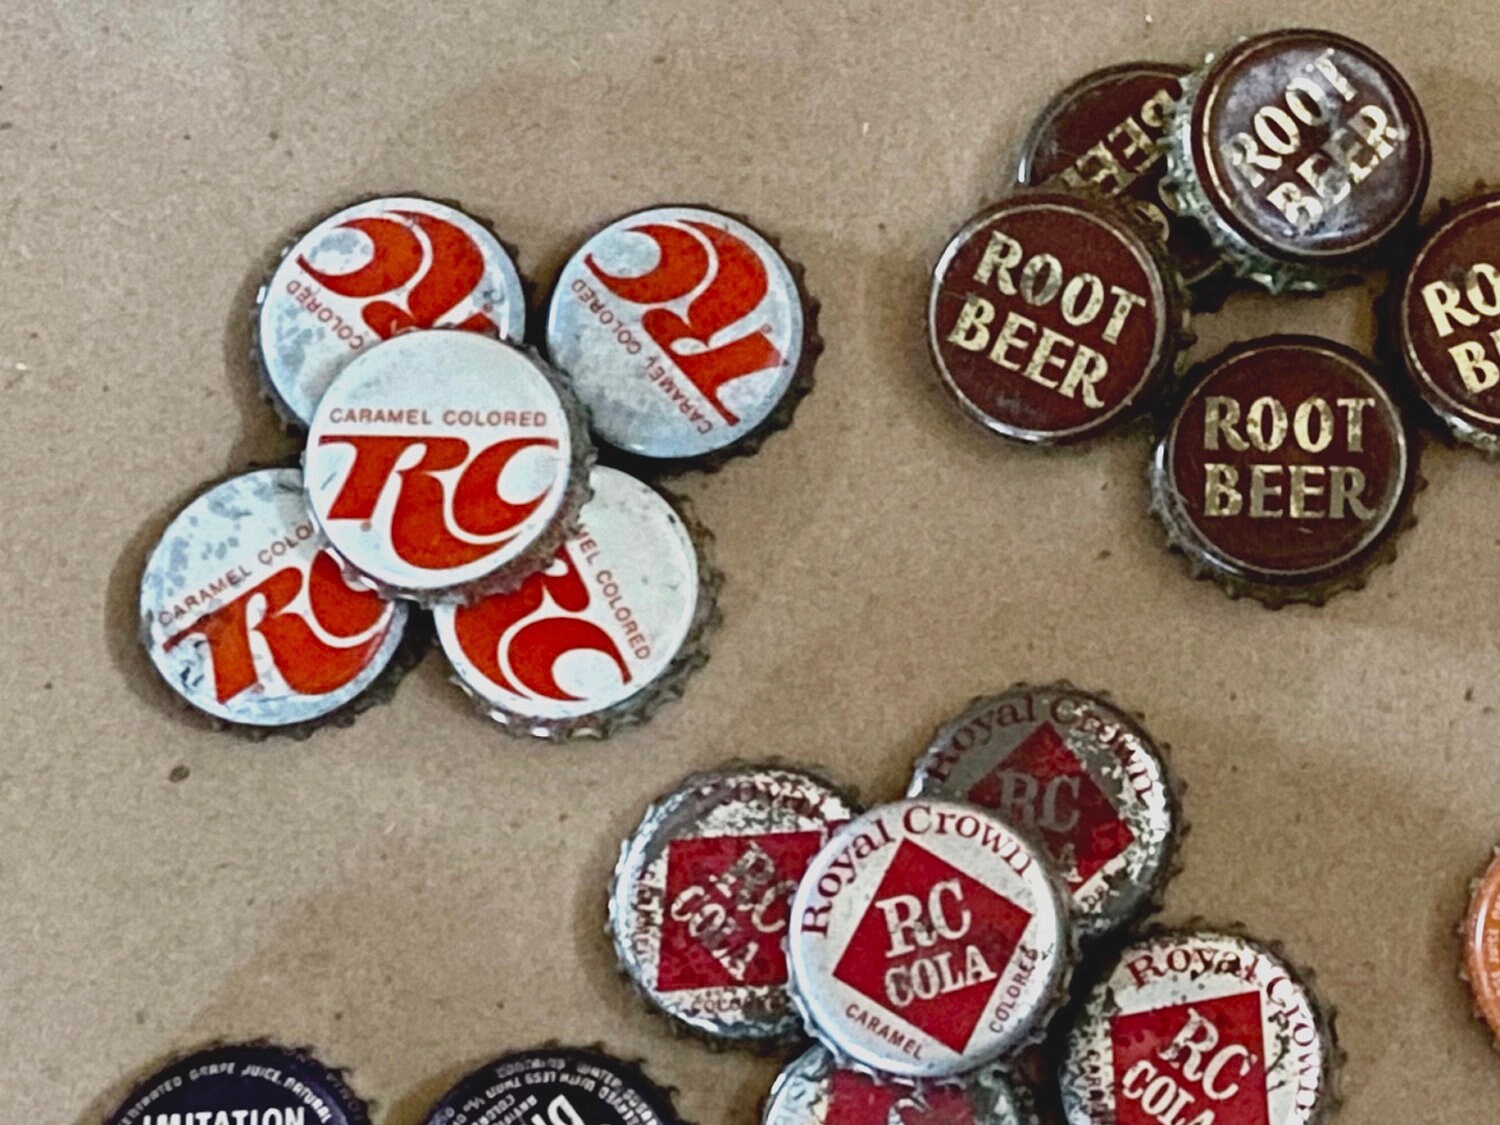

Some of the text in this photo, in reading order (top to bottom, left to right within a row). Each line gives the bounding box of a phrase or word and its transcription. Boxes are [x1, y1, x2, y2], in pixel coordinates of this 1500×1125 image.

[1061, 89, 1175, 196] BEE
[1222, 49, 1358, 188] ROOT
[1267, 105, 1409, 232] BEER
[584, 219, 789, 426] RC
[972, 230, 1147, 347] ROOT
[570, 277, 713, 435] CARAMEL COLORED
[947, 297, 1110, 410] BEER
[329, 407, 548, 428] CARAMEL COLORED
[1204, 396, 1375, 453] ROOT
[318, 435, 559, 570] RC
[1203, 463, 1377, 520] BEER
[159, 565, 253, 627] CARAMEL
[162, 548, 394, 706] RC
[596, 567, 651, 662] COLORED
[926, 693, 1036, 784] Royal
[1000, 767, 1082, 833] RC
[801, 818, 896, 938] Royal
[903, 805, 1035, 877] Crown
[875, 878, 972, 959] RC
[884, 944, 998, 1009] COLA
[988, 943, 1040, 1034] COLORED
[1126, 948, 1260, 990] Royal
[845, 1002, 923, 1061] CARAMEL
[1156, 1007, 1259, 1101] RC
[189, 1062, 236, 1081] GRAPE
[282, 1077, 333, 1125] NATURAL
